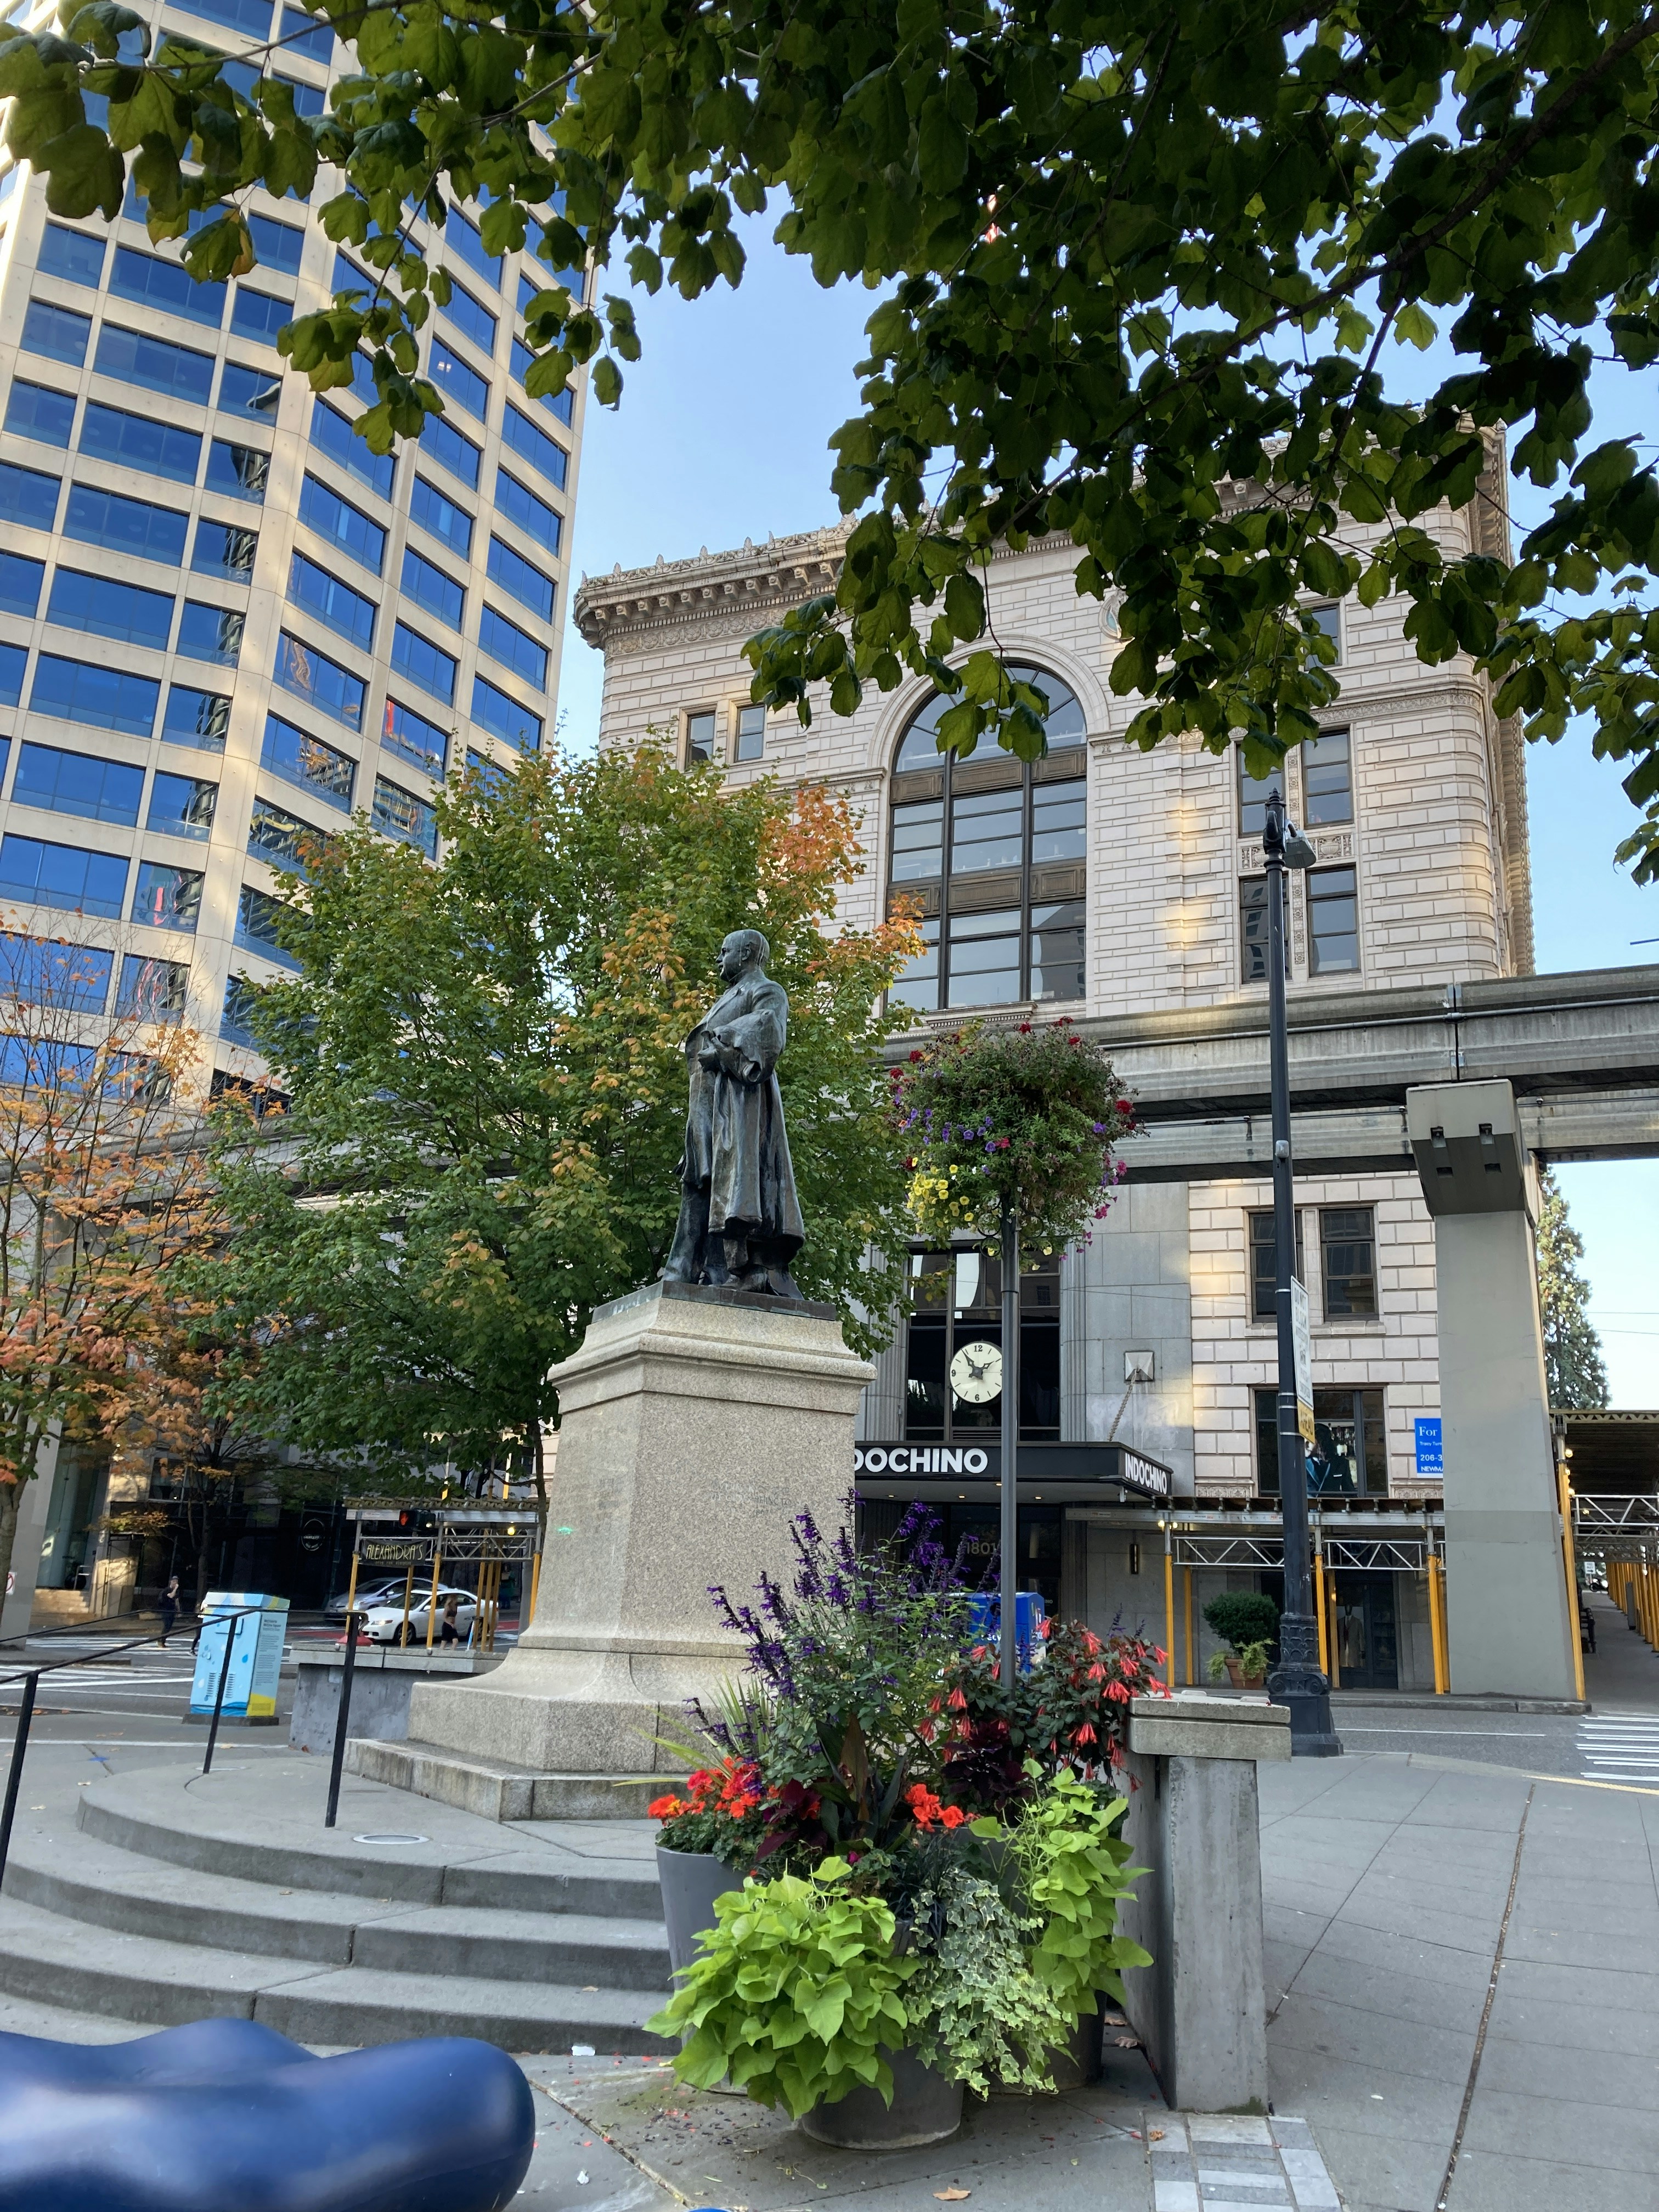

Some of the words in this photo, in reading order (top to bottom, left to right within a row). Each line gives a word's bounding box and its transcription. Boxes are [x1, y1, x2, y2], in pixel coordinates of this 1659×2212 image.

[1300, 1409, 1314, 1436] AHEAD
[1419, 1426, 1438, 1436] For
[1125, 1452, 1167, 1495] INDOCHINO
[366, 1544, 423, 1560] ALEXANDRA'S
